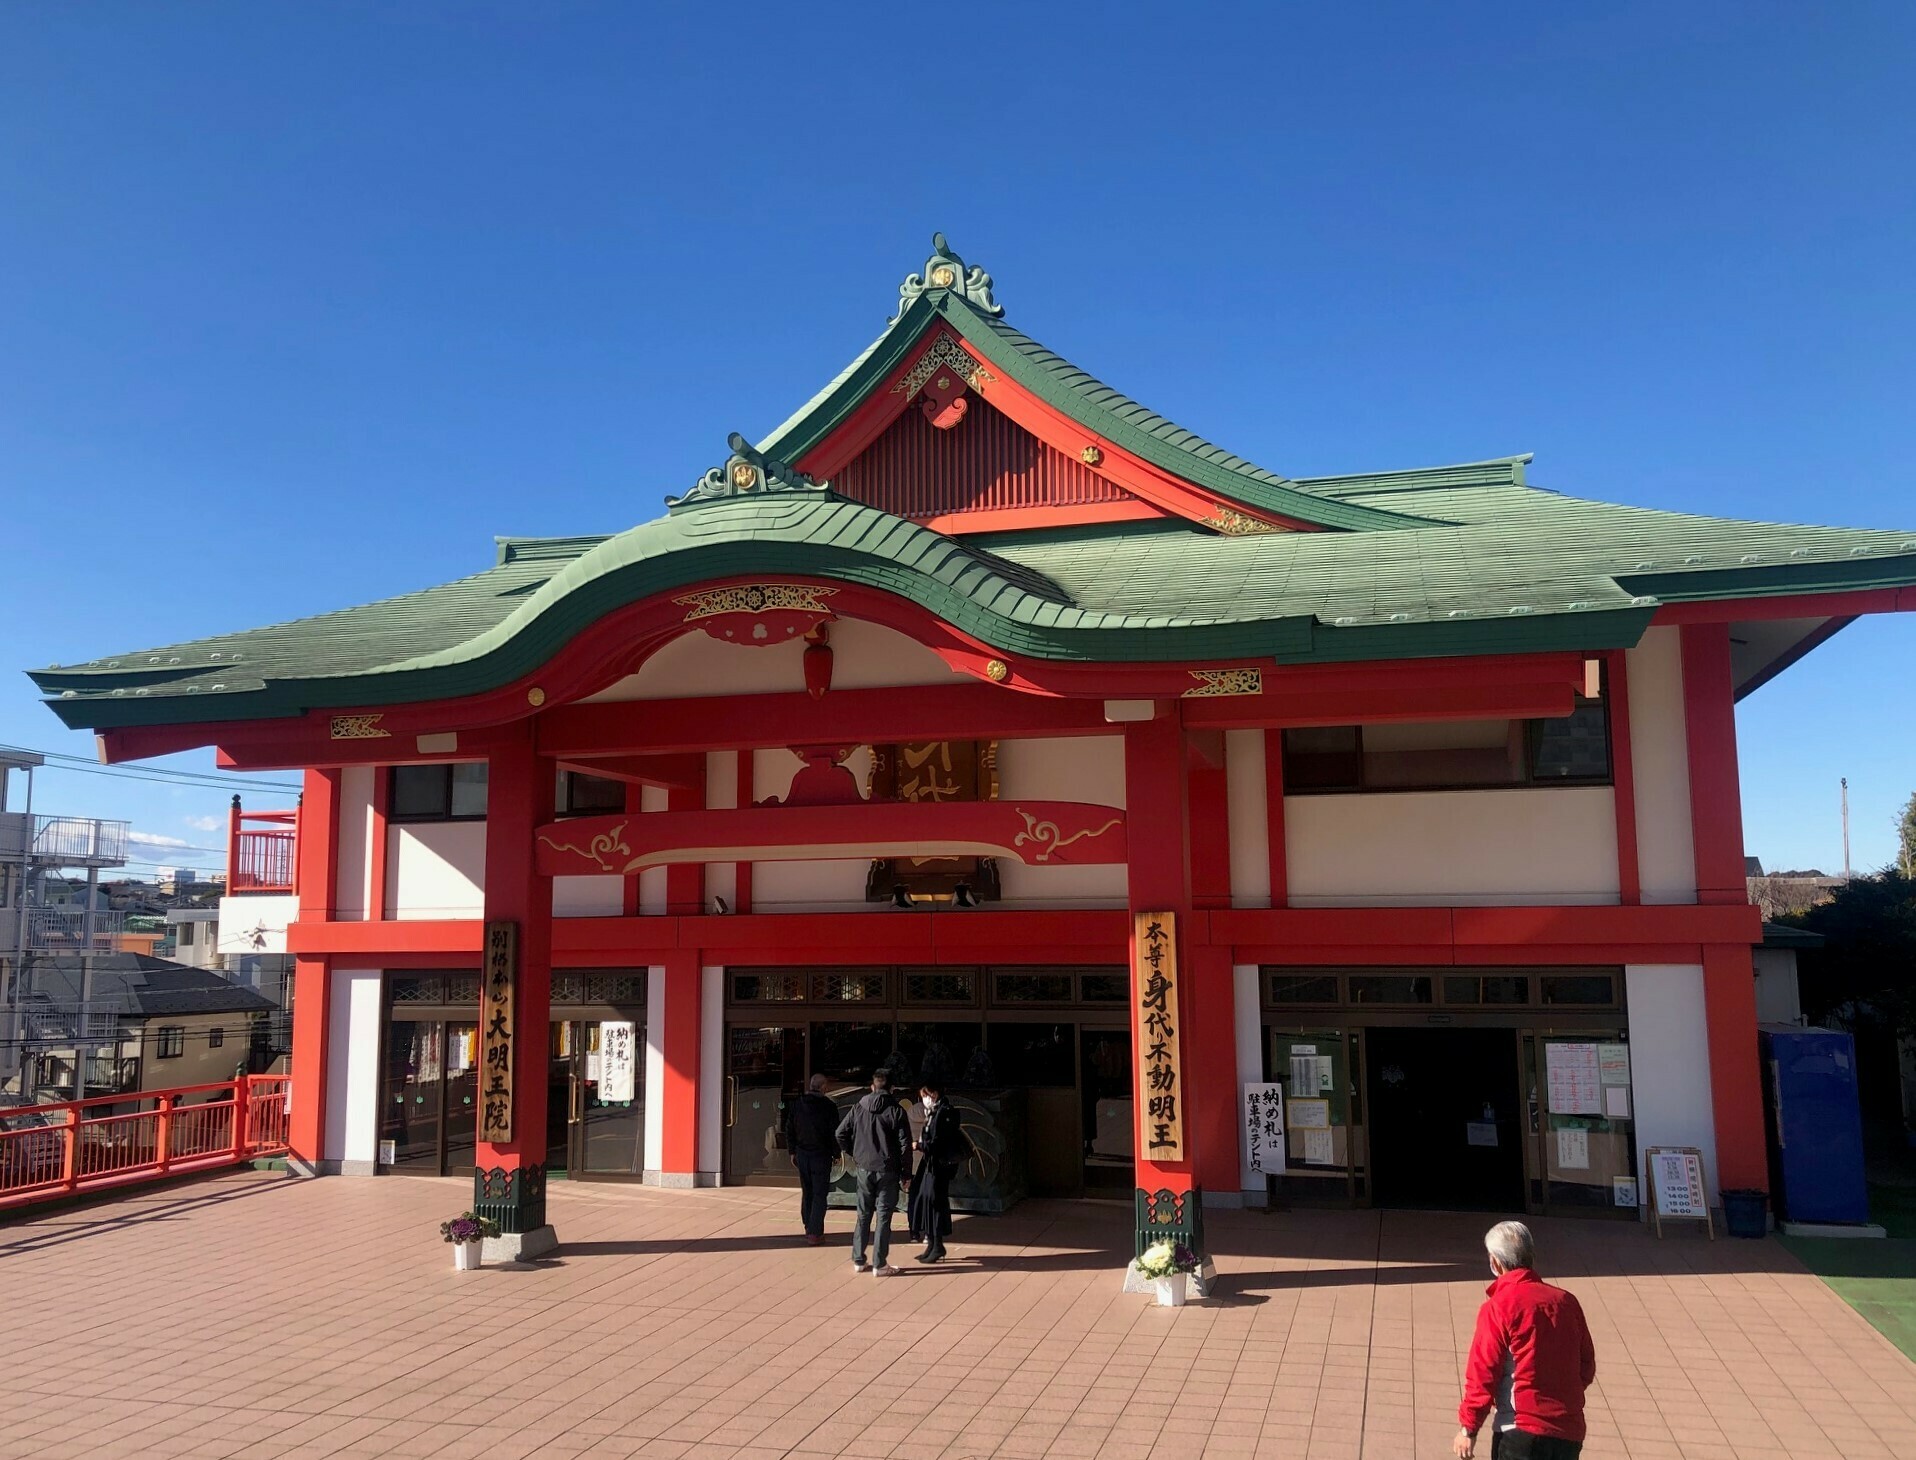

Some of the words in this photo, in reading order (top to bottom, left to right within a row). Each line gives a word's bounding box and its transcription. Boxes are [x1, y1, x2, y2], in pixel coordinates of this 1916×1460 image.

[616, 1026, 629, 1070] 納め札は
[1246, 1092, 1263, 1173] 駐車場のテント内へ
[1262, 1087, 1283, 1149] 納め札は
